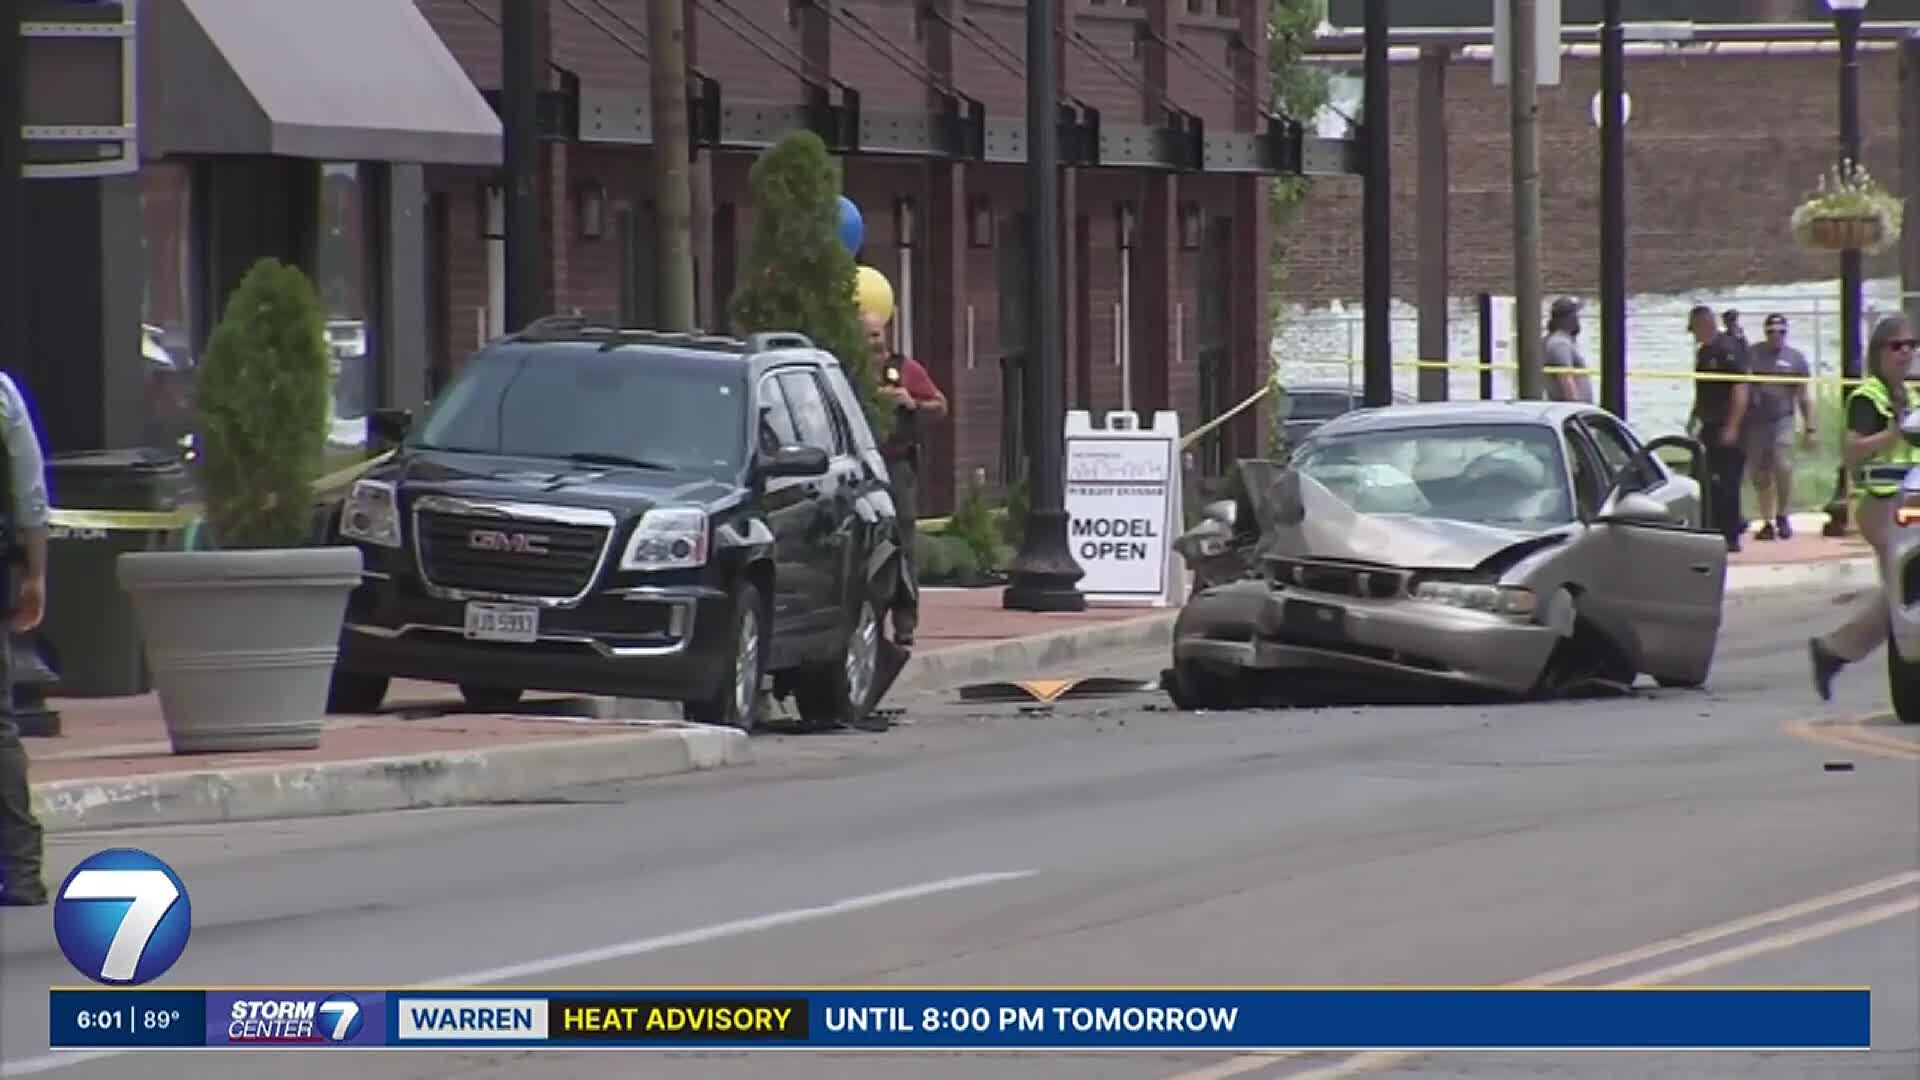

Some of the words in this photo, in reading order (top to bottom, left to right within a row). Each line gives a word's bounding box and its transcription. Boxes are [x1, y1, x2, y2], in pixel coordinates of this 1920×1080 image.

[1072, 518, 1158, 537] MODEL
[467, 529, 551, 555] GMC
[1080, 542, 1147, 560] OPEN
